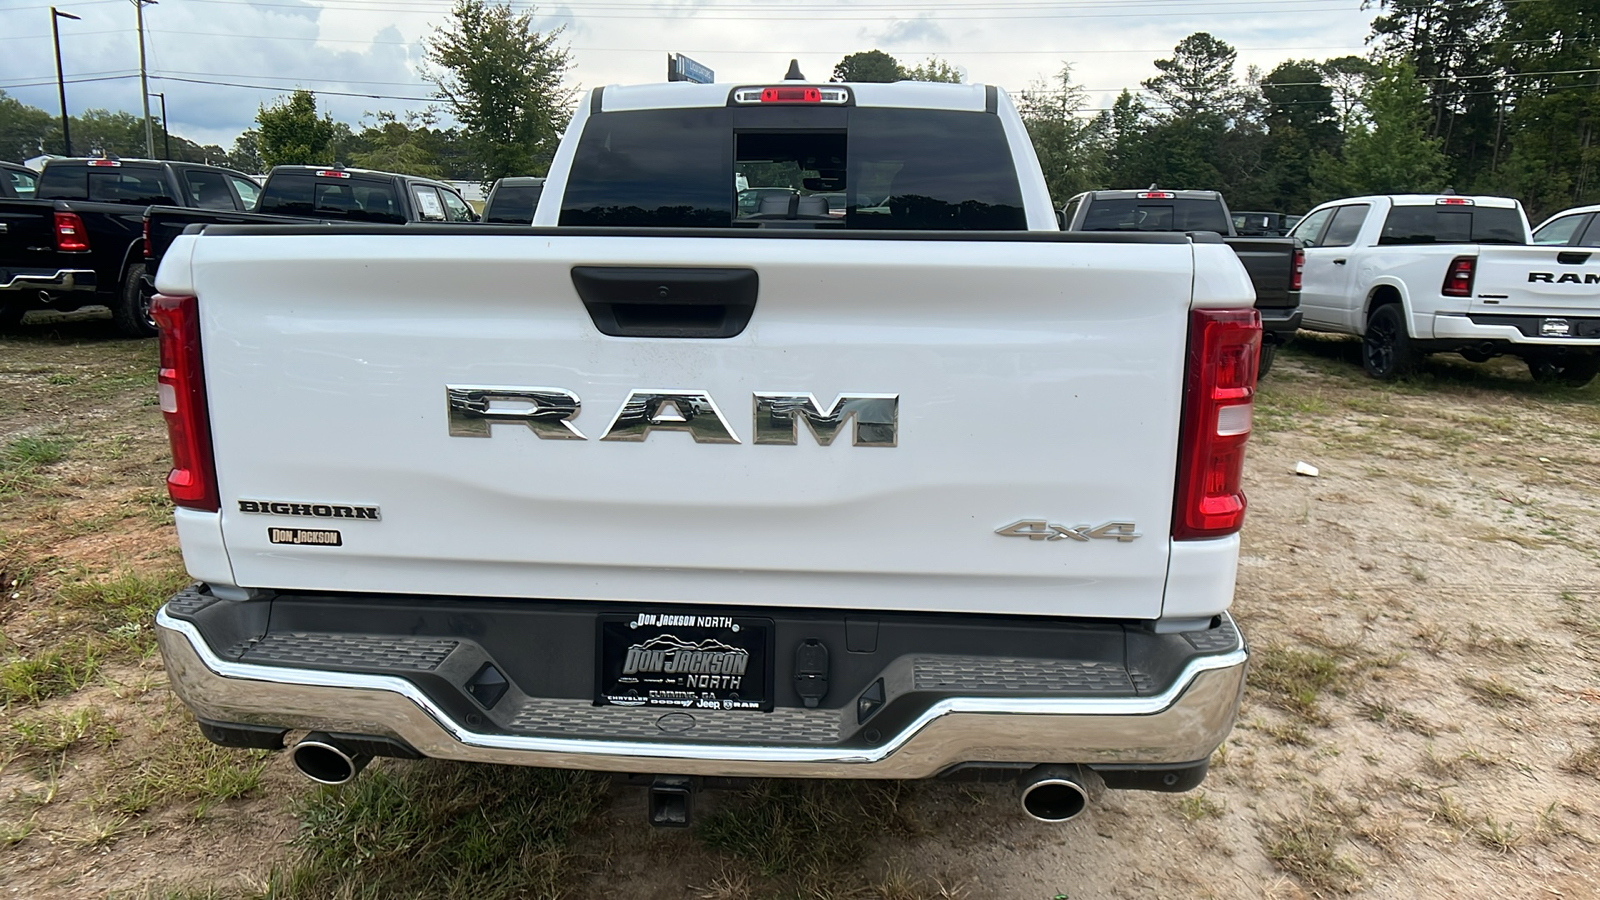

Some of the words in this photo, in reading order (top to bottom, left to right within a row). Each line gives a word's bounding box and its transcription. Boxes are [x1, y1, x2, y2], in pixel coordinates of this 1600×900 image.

[445, 384, 900, 447] RAM
[238, 500, 382, 521] BIGHORN
[272, 529, 293, 542] DON
[294, 530, 338, 544] JACKSON
[637, 613, 657, 627] DON
[657, 614, 695, 627] JACKSON
[697, 616, 733, 628] NORTH
[622, 650, 667, 674] DON
[665, 651, 749, 675] JACKSON
[686, 674, 742, 690] NORTH
[650, 699, 692, 707] DODGE
[696, 699, 721, 710] Jeep
